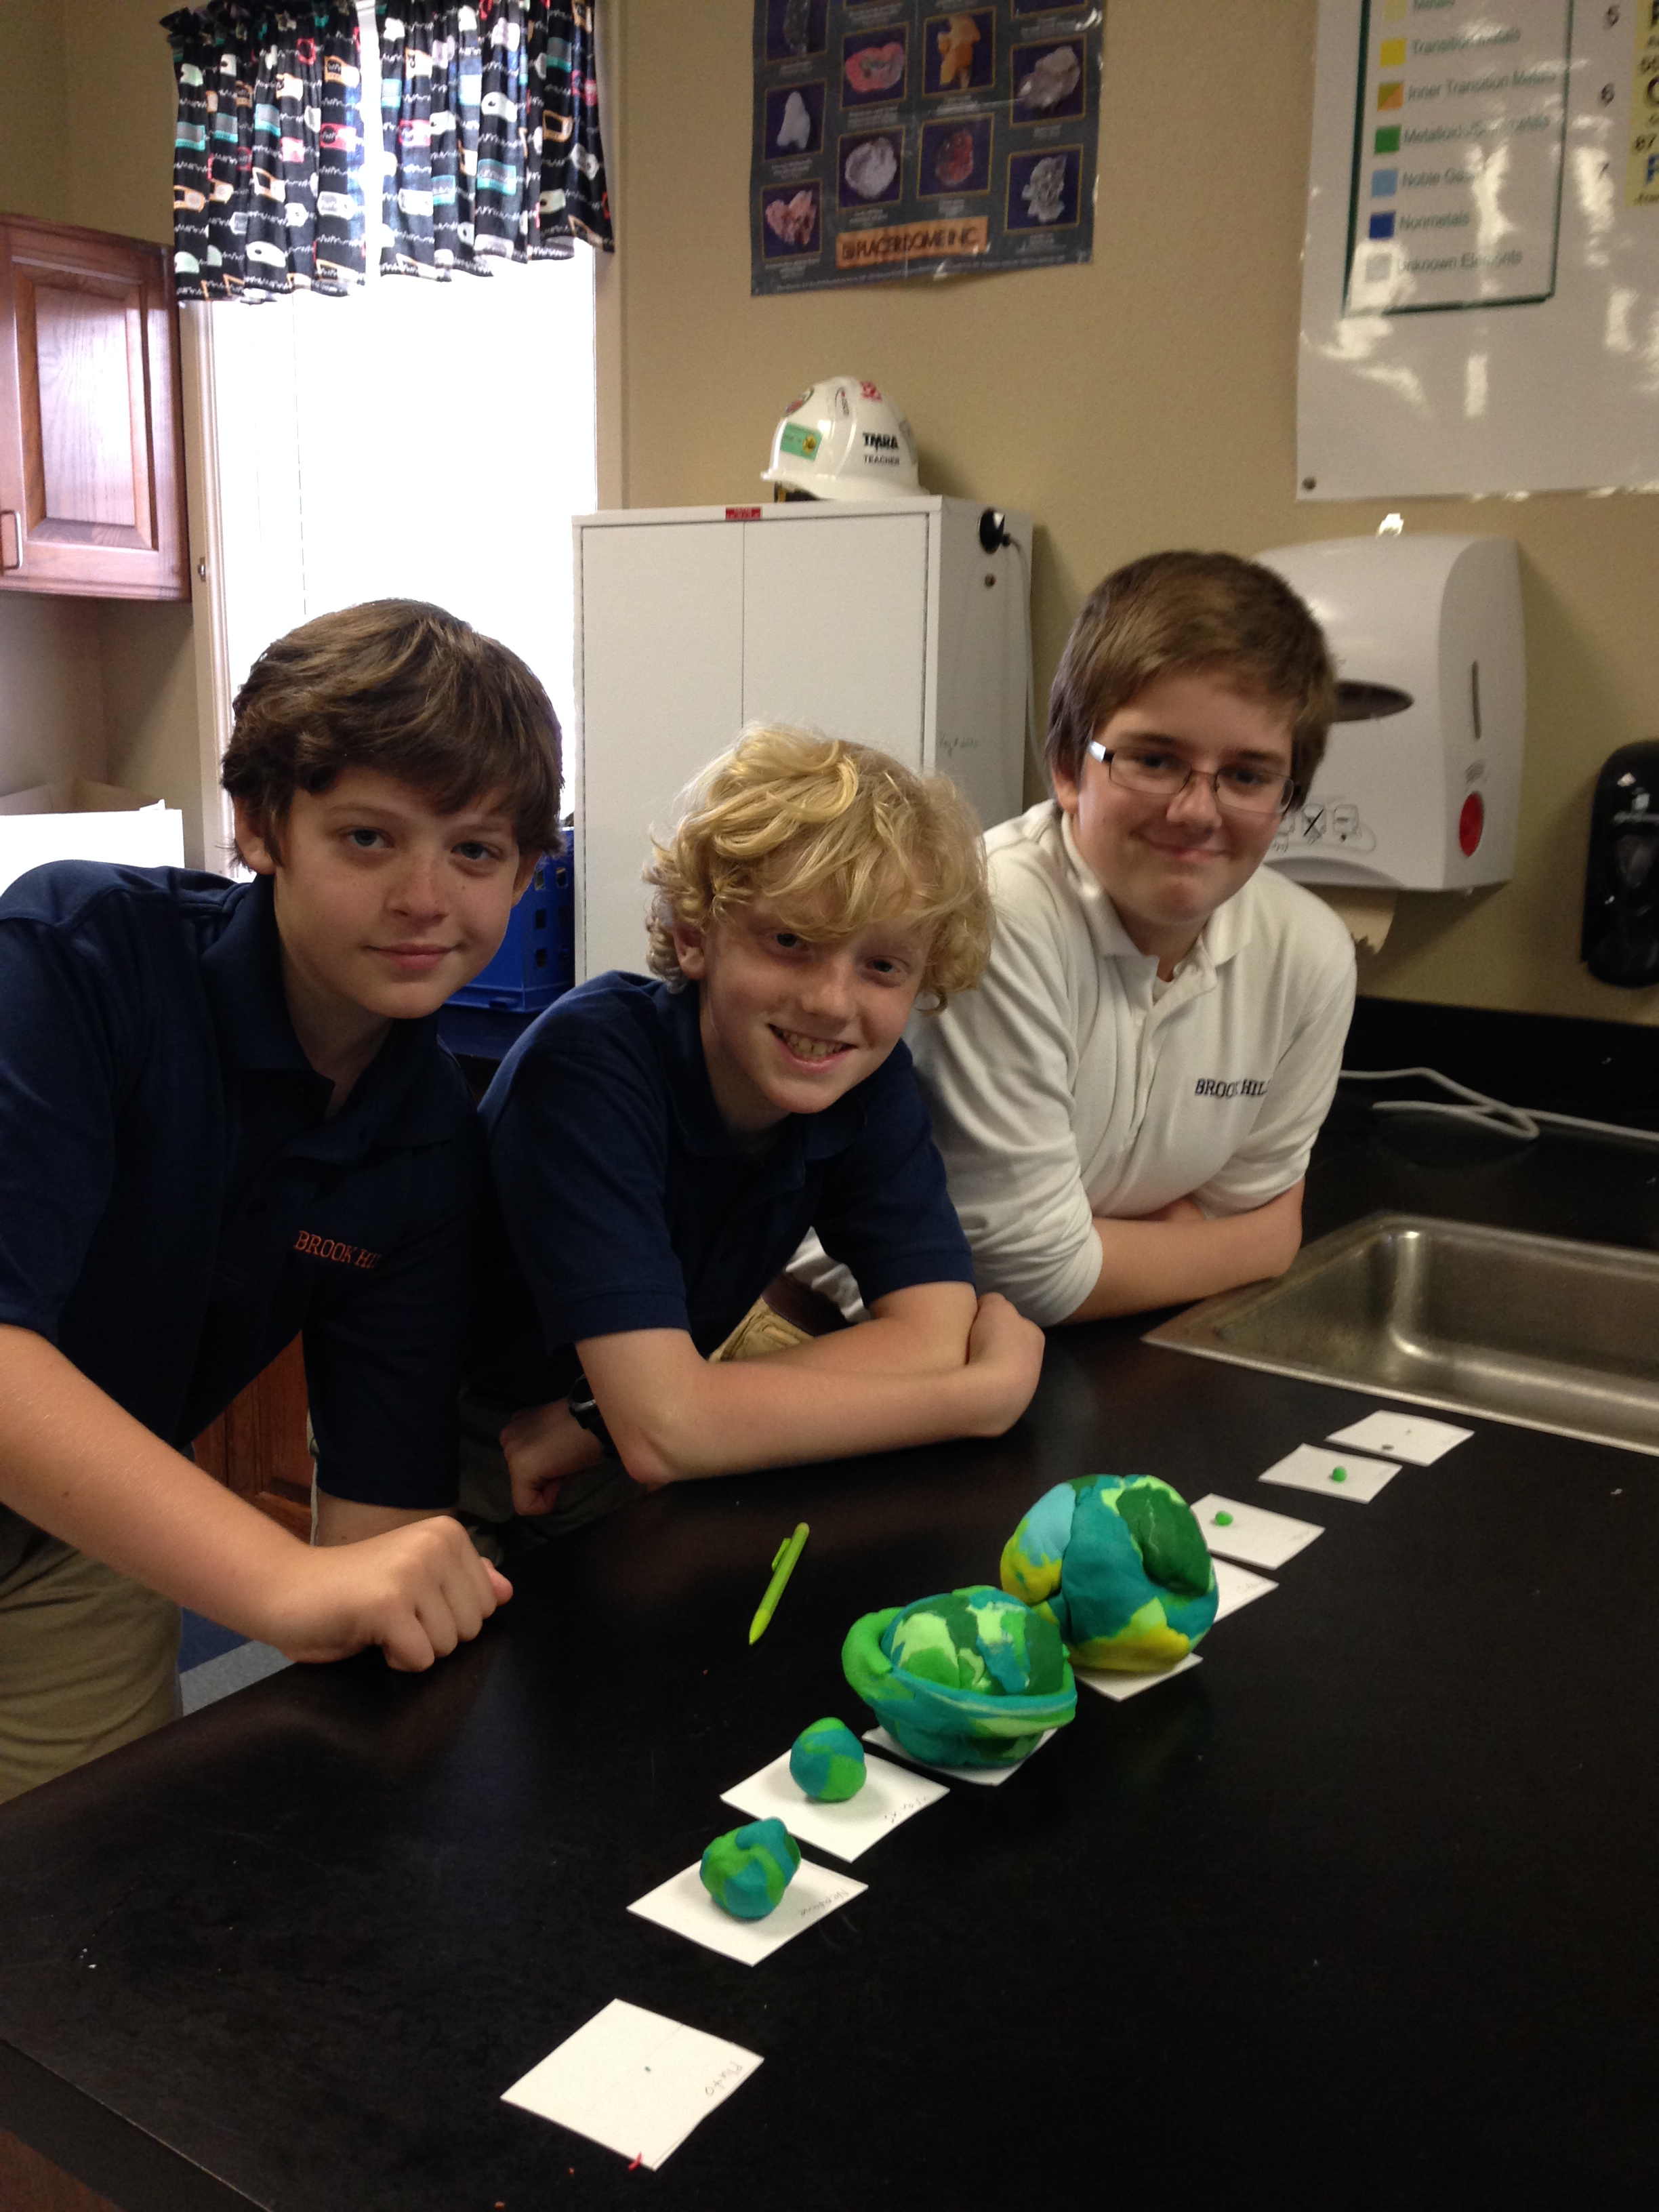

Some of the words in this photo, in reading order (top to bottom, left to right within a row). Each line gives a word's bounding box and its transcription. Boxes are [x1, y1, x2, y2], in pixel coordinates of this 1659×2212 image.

[1408, 84, 1441, 102] Inner
[1446, 73, 1509, 94] Transition
[1600, 81, 1615, 104] 6
[1402, 171, 1440, 188] Noble
[1460, 249, 1523, 268] Elnts
[863, 454, 901, 466] TEACHER
[293, 1229, 357, 1264] BROOK
